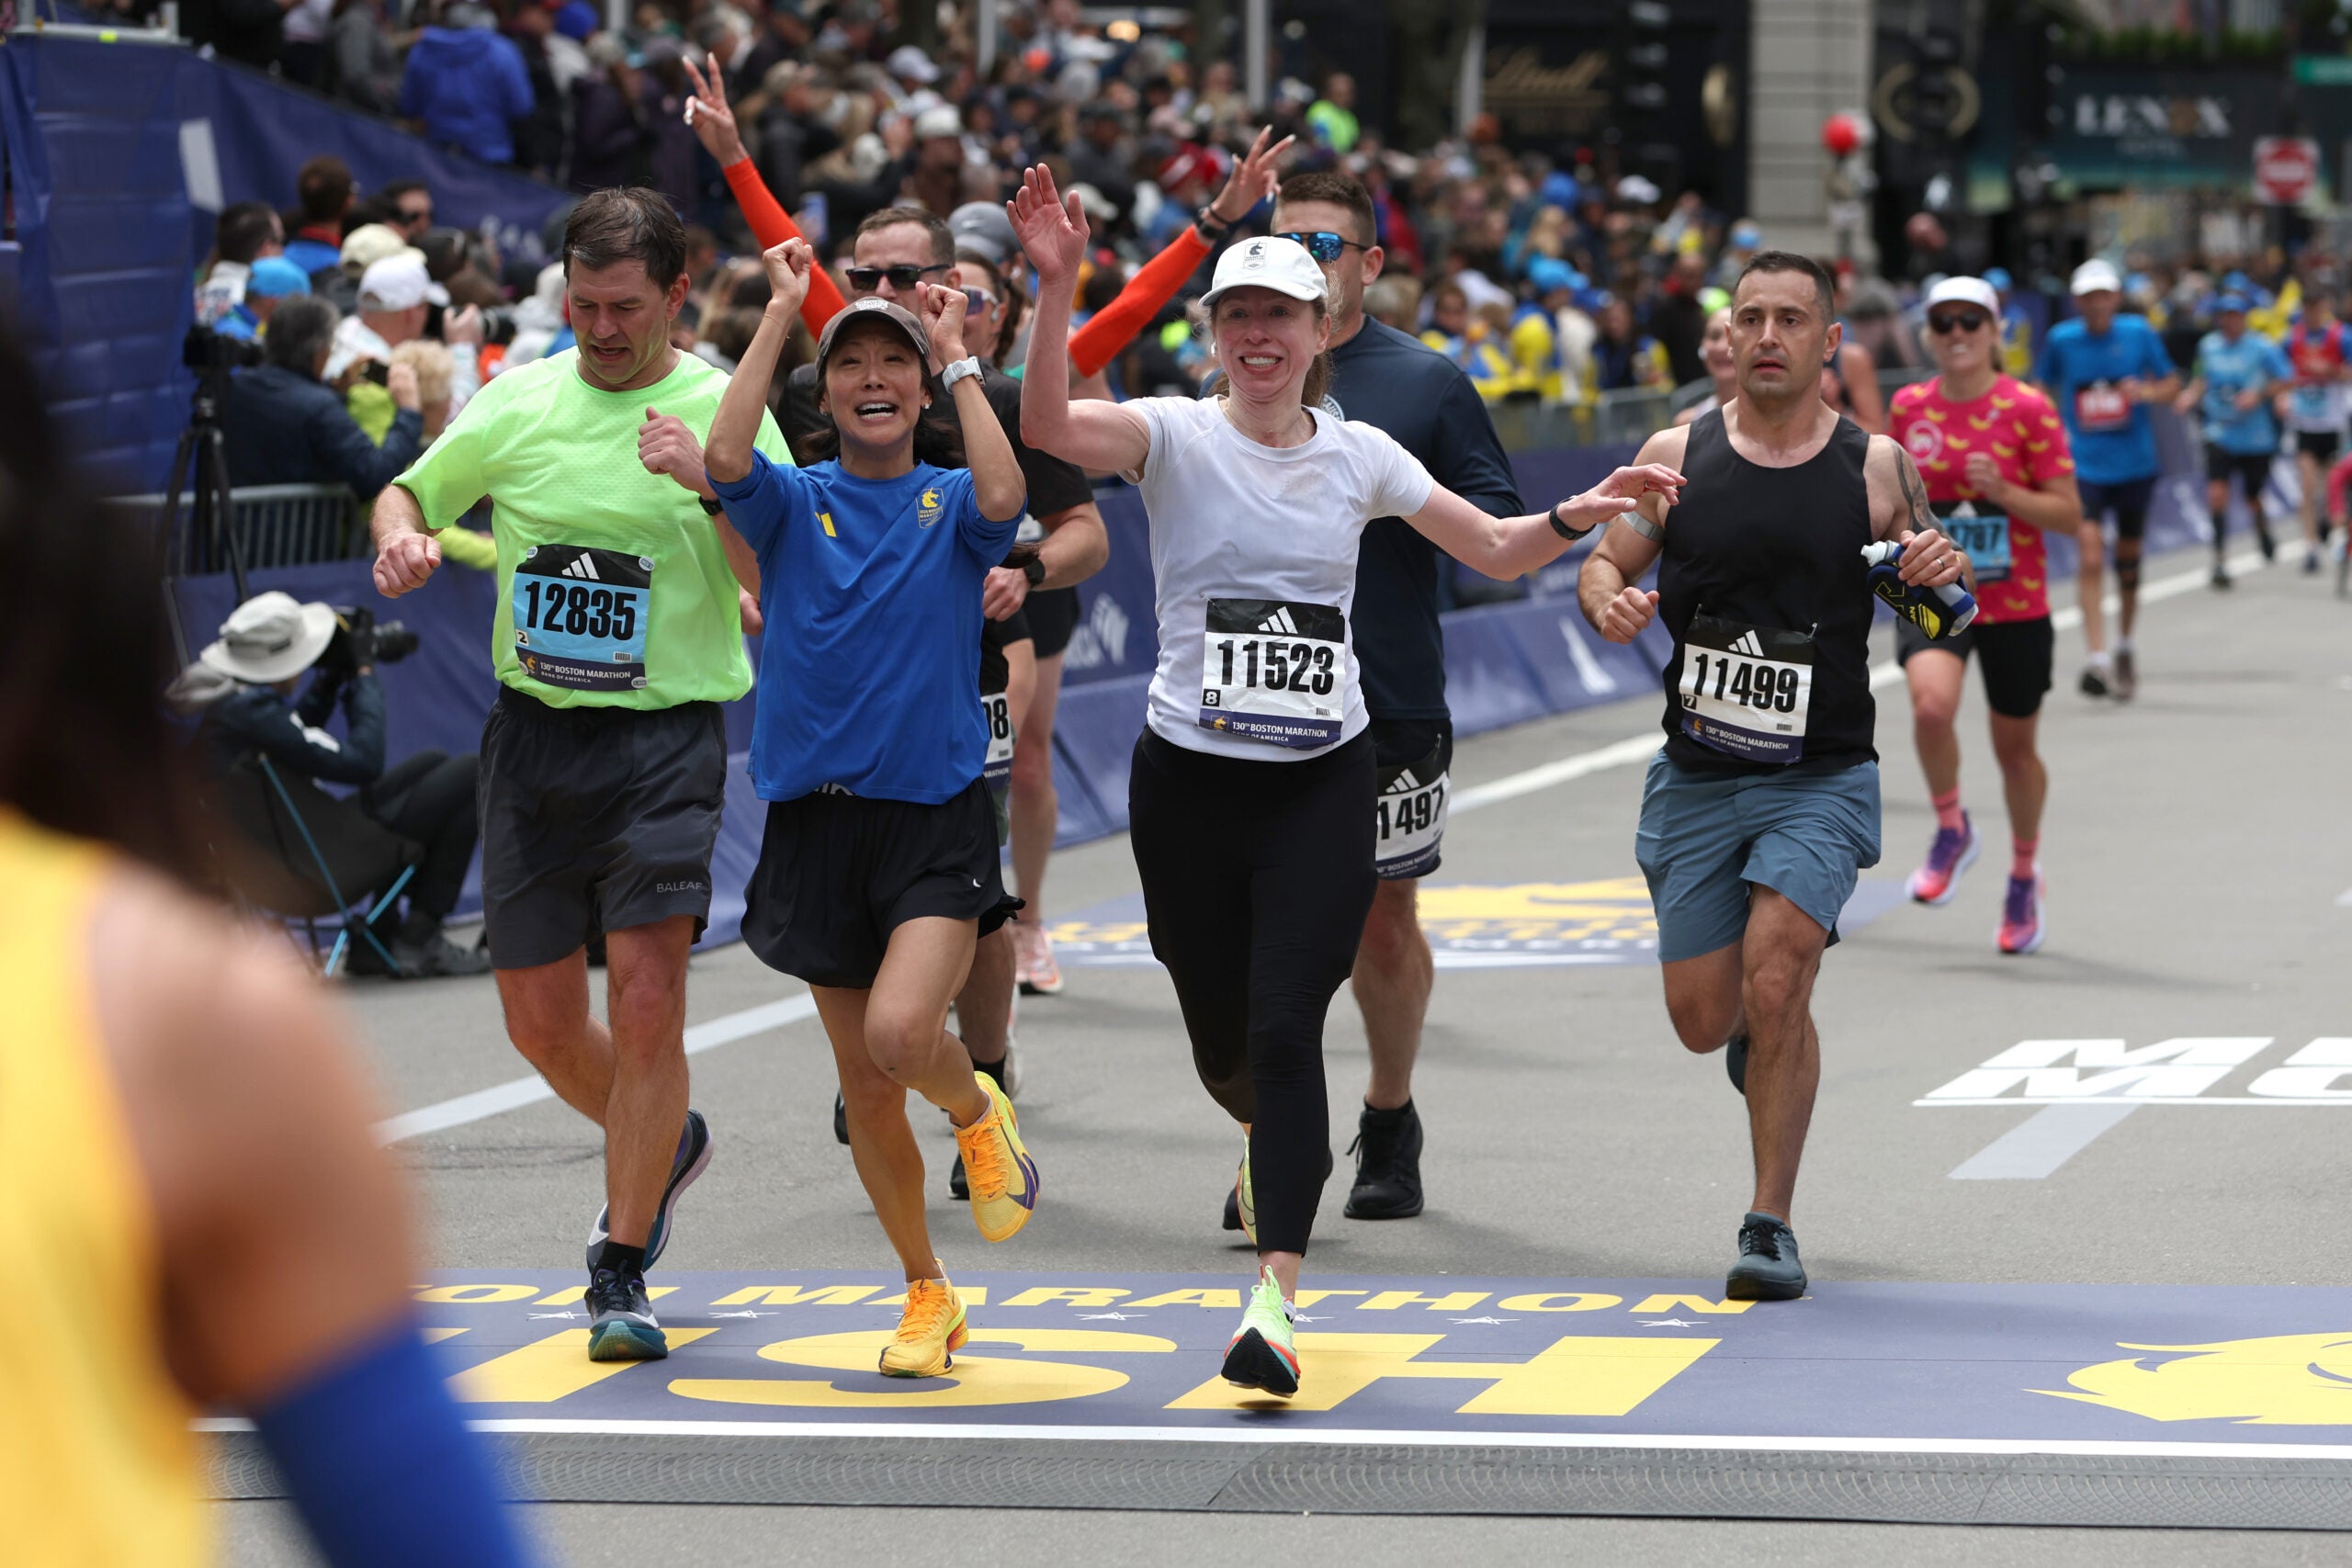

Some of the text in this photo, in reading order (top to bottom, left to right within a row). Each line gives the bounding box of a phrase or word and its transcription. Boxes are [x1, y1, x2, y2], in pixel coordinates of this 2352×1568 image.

[525, 581, 638, 641] 12835
[518, 632, 527, 644] 2
[555, 666, 585, 677] BOSTON
[586, 670, 631, 679] MARATHON
[1217, 639, 1334, 695] 11523
[1693, 653, 1799, 714] 11499
[1204, 691, 1218, 705] 8
[1686, 695, 1694, 707] 7
[1250, 724, 1283, 735] BOSTON
[1284, 727, 1328, 739] MARATHON
[1260, 734, 1289, 743] AMERICA
[1719, 729, 1747, 743] BOSTON
[1747, 738, 1790, 750] MARATHON
[1727, 741, 1751, 751] AMERICA
[656, 881, 703, 894] BALEAF
